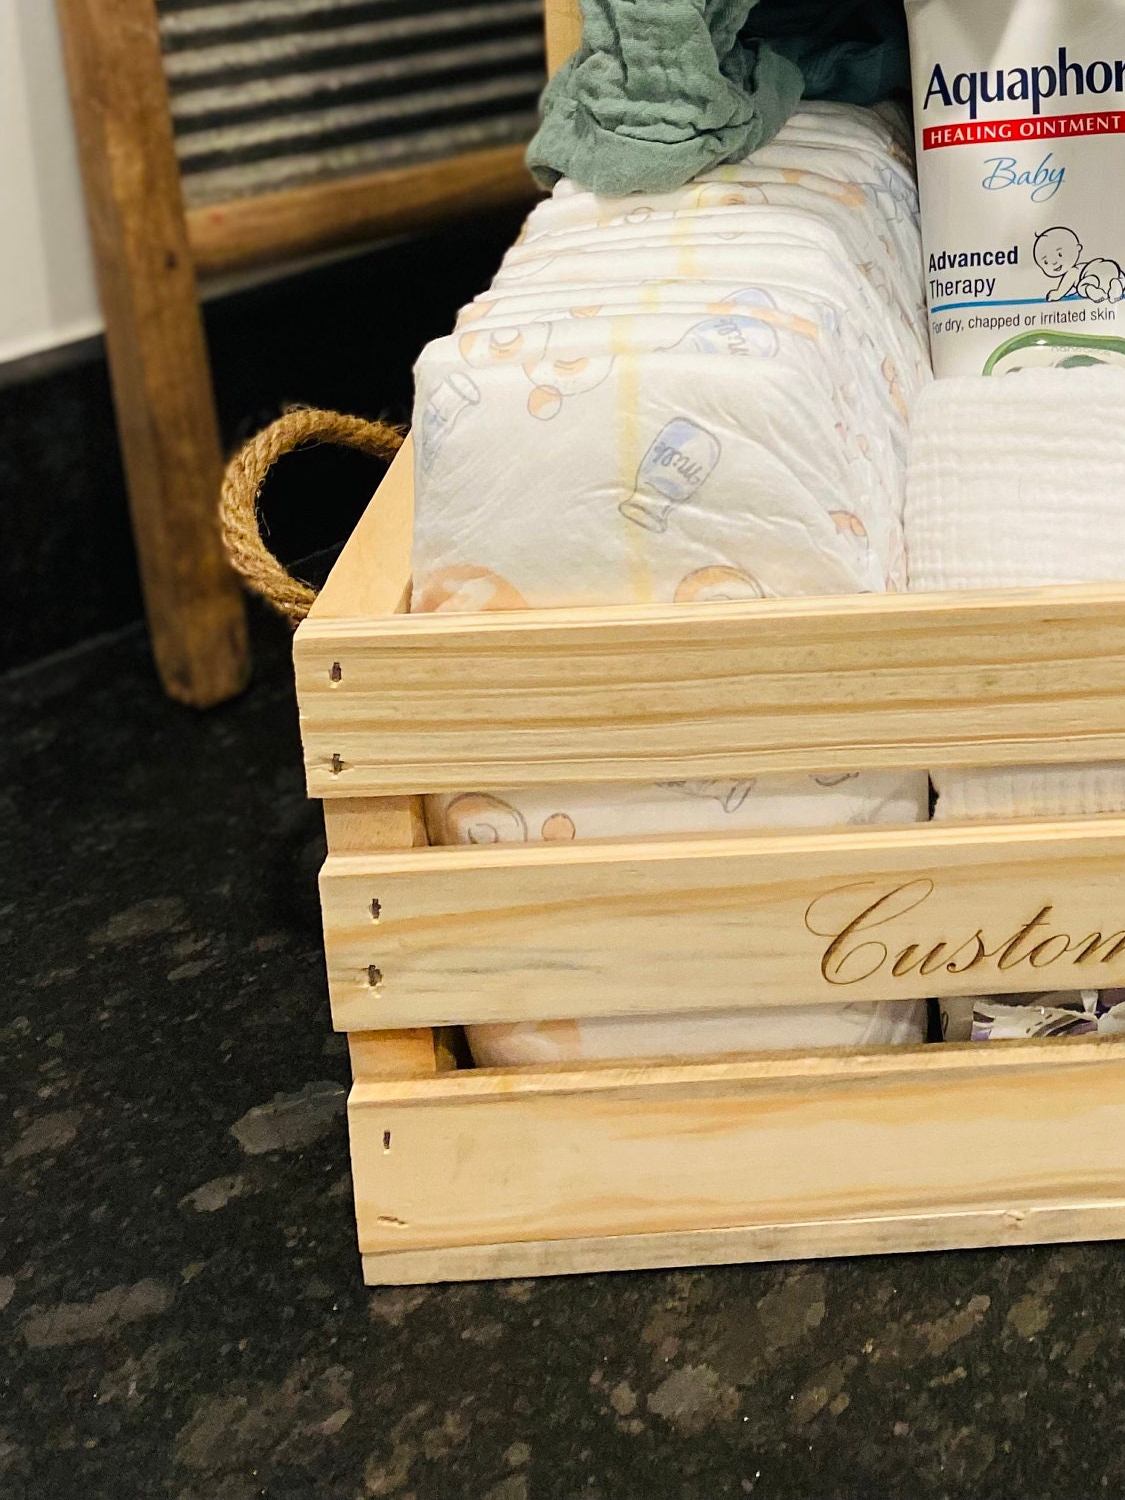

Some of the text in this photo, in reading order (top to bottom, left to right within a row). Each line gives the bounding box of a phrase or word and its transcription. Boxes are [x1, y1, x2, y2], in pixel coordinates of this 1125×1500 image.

[930, 115, 1122, 146] HEALING OINTMENT
[981, 153, 1067, 203] Baby
[928, 246, 1019, 273] Advanced
[929, 275, 996, 300] Therapy
[931, 307, 1116, 334] For dry, chapped or irritated skin
